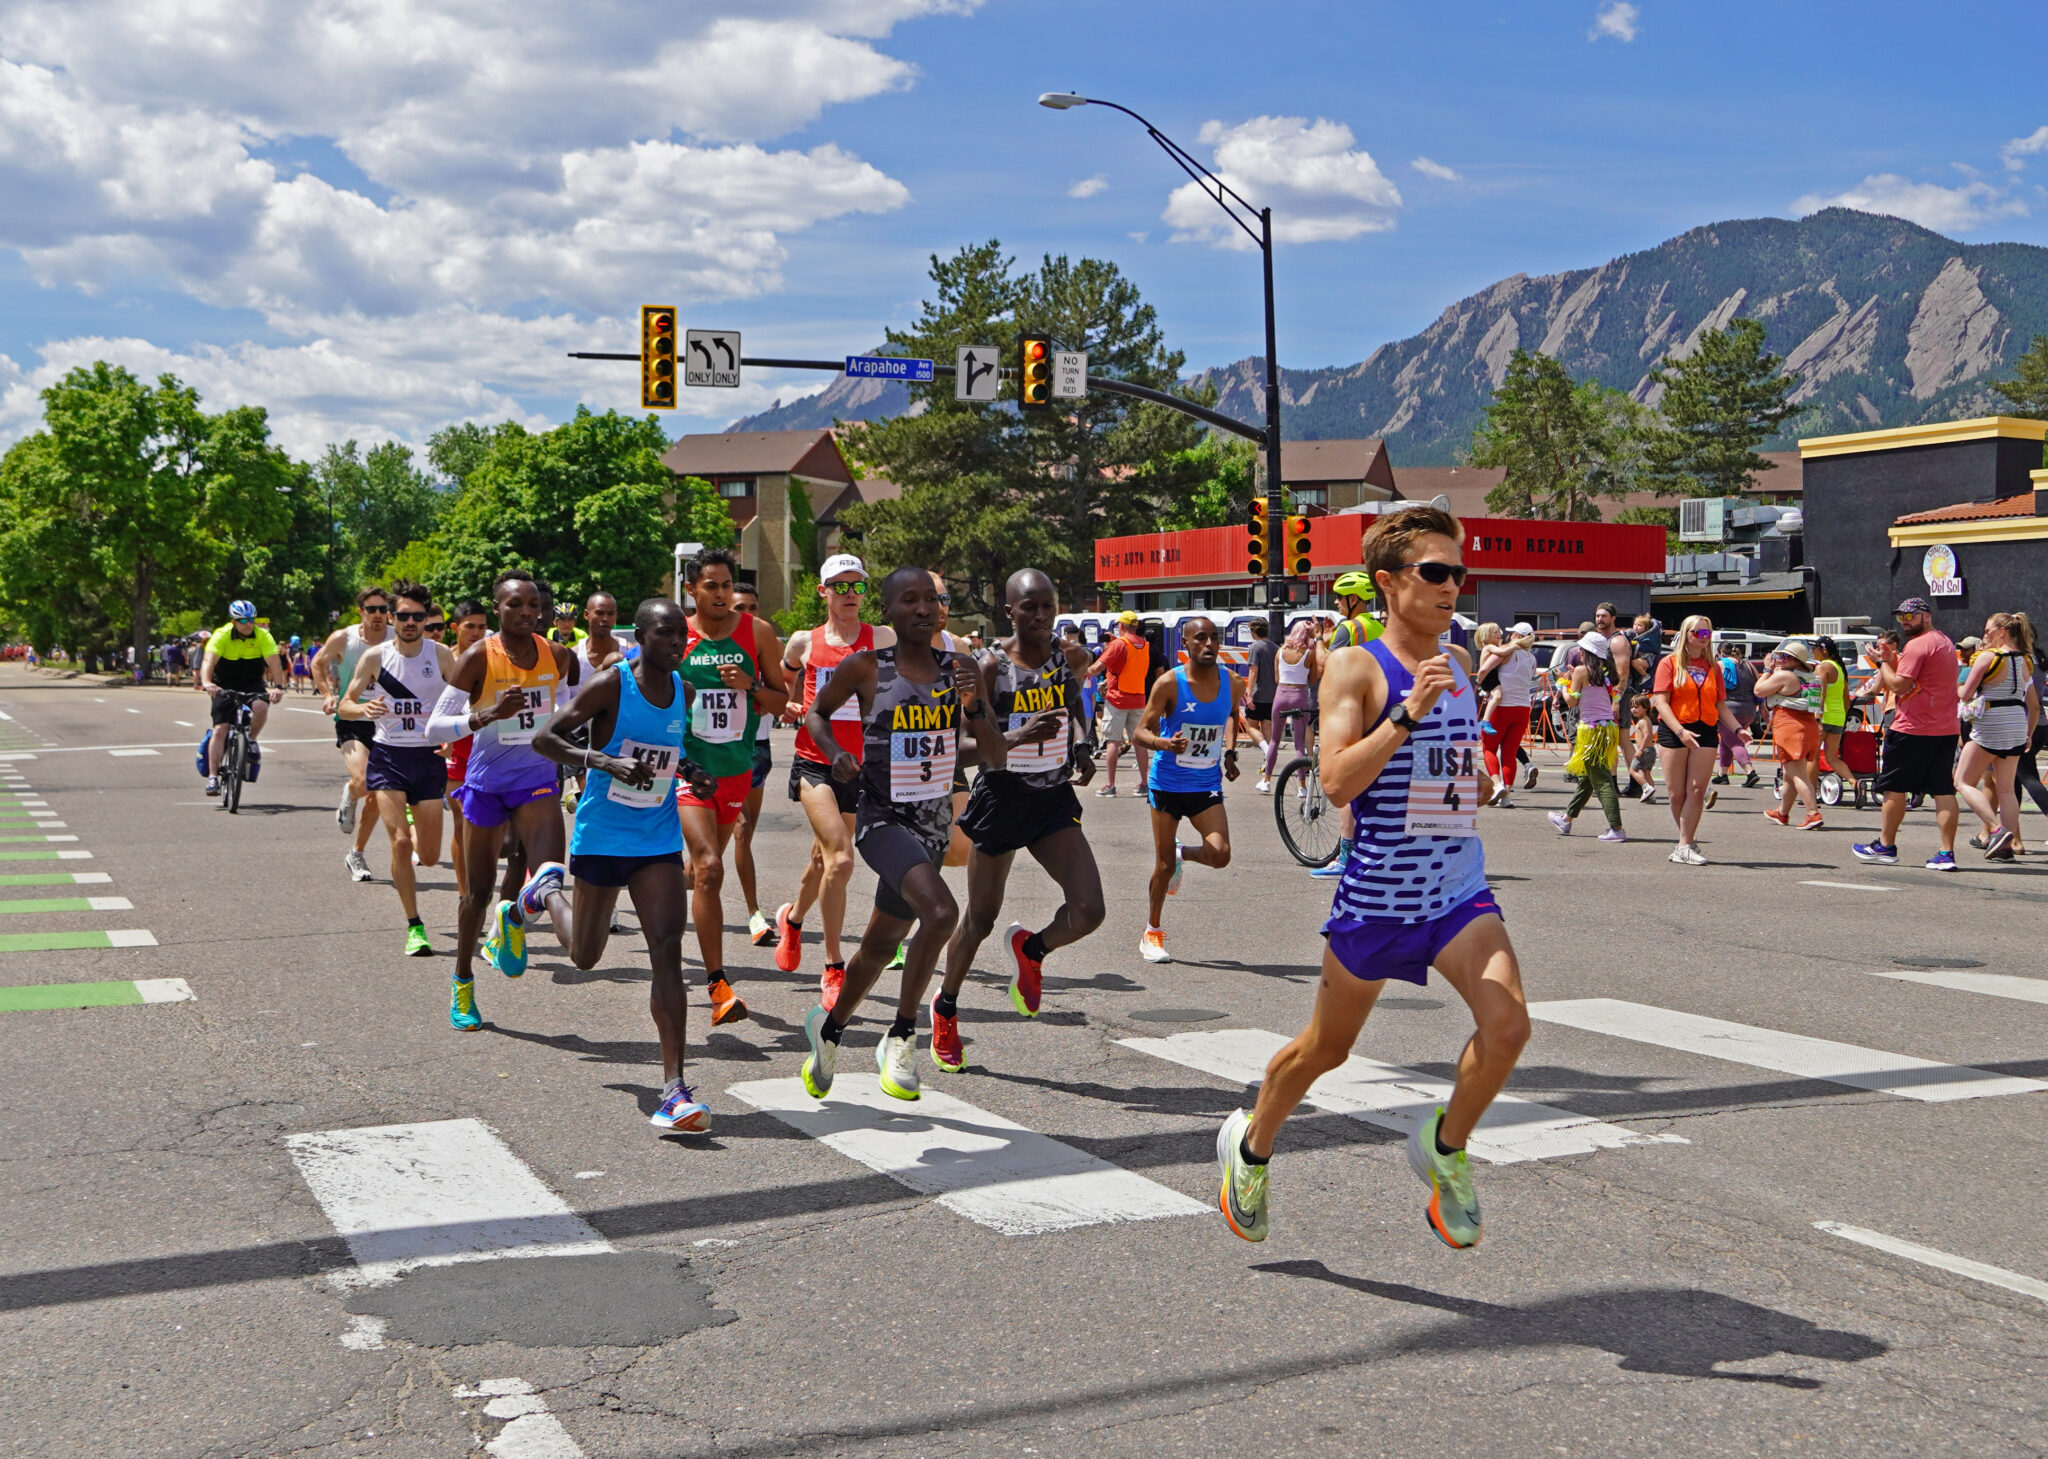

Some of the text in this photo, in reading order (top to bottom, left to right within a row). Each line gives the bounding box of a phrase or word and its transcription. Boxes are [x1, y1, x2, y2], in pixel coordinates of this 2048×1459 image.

[849, 358, 907, 376] Arapahoe
[918, 361, 930, 369] Ave
[1063, 356, 1078, 365] NO
[688, 371, 711, 382] ONLY
[715, 373, 737, 384] ONLY
[915, 370, 931, 379] 1500
[1062, 367, 1080, 375] TURN
[1065, 377, 1075, 385] ON
[1062, 386, 1077, 394] RED
[1472, 536, 1584, 554] AUTO REPAIR
[1124, 551, 1144, 565] AUTO
[1150, 548, 1180, 563] REPAIR
[1931, 580, 1960, 593] Del Sol
[689, 653, 744, 666] MÉXICO
[521, 690, 542, 709] EN
[702, 693, 738, 710] MEX
[1013, 683, 1065, 712] ARMY
[394, 702, 422, 715] GBR
[401, 717, 415, 731] 10
[518, 711, 535, 729] 13
[711, 712, 728, 729] 19
[892, 704, 955, 730] ARMY
[1190, 727, 1217, 742] TAN
[904, 735, 946, 758] USA
[1191, 743, 1210, 757] 24
[632, 746, 672, 770] KEN
[1428, 747, 1474, 777] USA
[920, 761, 932, 782] 3
[1443, 782, 1460, 811] 4
